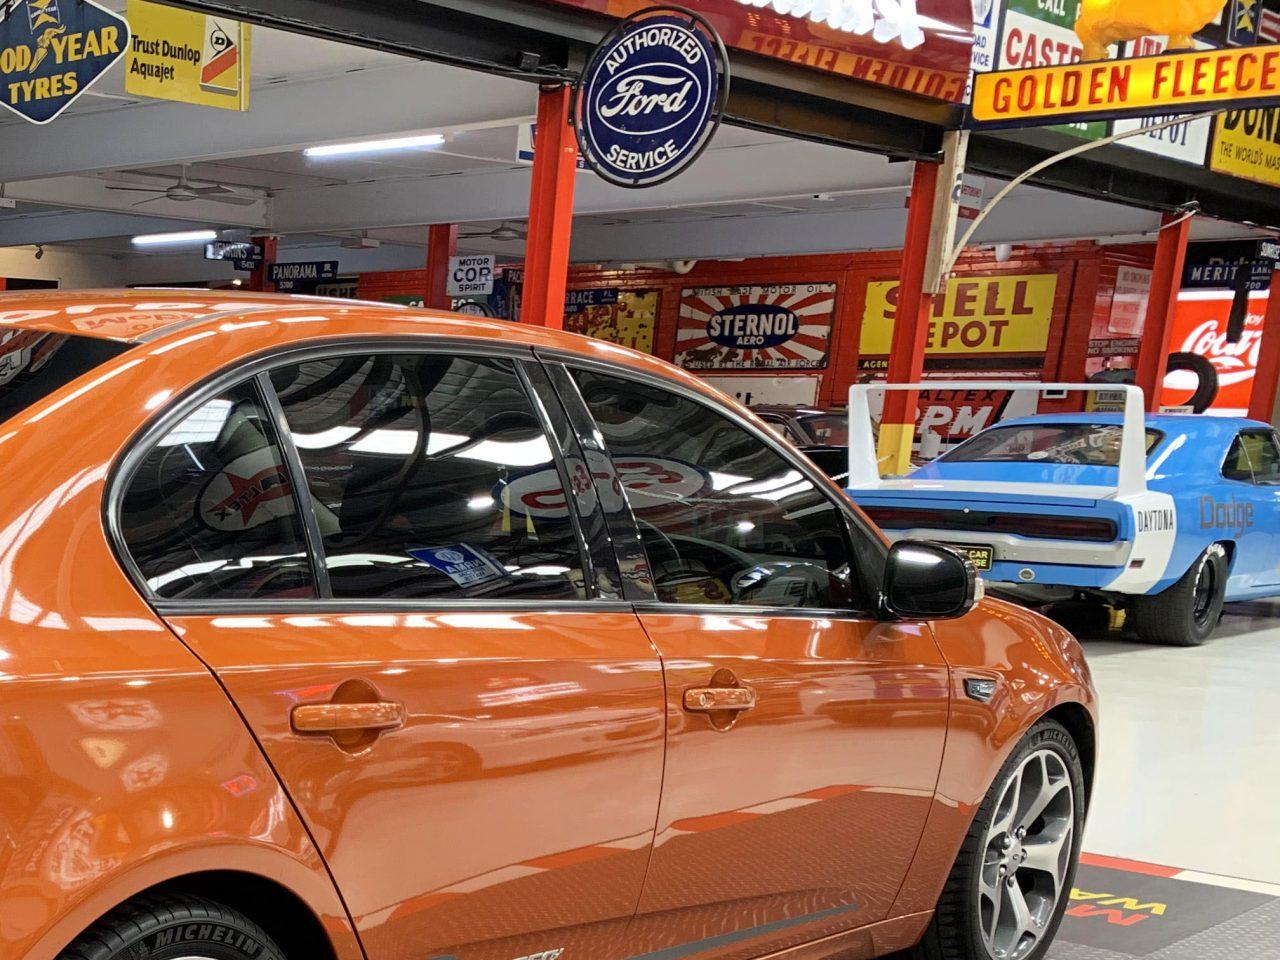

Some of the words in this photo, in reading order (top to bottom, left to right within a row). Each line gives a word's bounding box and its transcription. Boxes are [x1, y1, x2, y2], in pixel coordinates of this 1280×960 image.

[50, 26, 119, 64] YEAR
[131, 34, 160, 56] Trust
[162, 41, 201, 66] Dunlop
[606, 30, 702, 75] AUTHORIZED
[130, 58, 174, 83] Aquajet
[992, 64, 1132, 113] GOLDEN
[1152, 52, 1280, 99] FLEECE
[8, 72, 78, 104] TYRES
[601, 75, 692, 117] Ford
[606, 140, 680, 170] SERVICE
[1220, 140, 1233, 156] THE
[1235, 145, 1263, 166] WORLD'S
[273, 264, 318, 280] PANORAMA
[458, 257, 490, 266] MOTOR
[1191, 266, 1238, 281] MERIT
[458, 283, 486, 292] SPIRIT
[710, 313, 796, 337] STERNOL
[1244, 313, 1265, 326] joy
[736, 336, 764, 346] AERO
[925, 320, 1010, 348] EPOT
[863, 360, 888, 369] AGEN
[1138, 509, 1174, 533] DAYTONA
[1199, 496, 1254, 539] Dodge
[155, 924, 259, 956] MICHELIN
